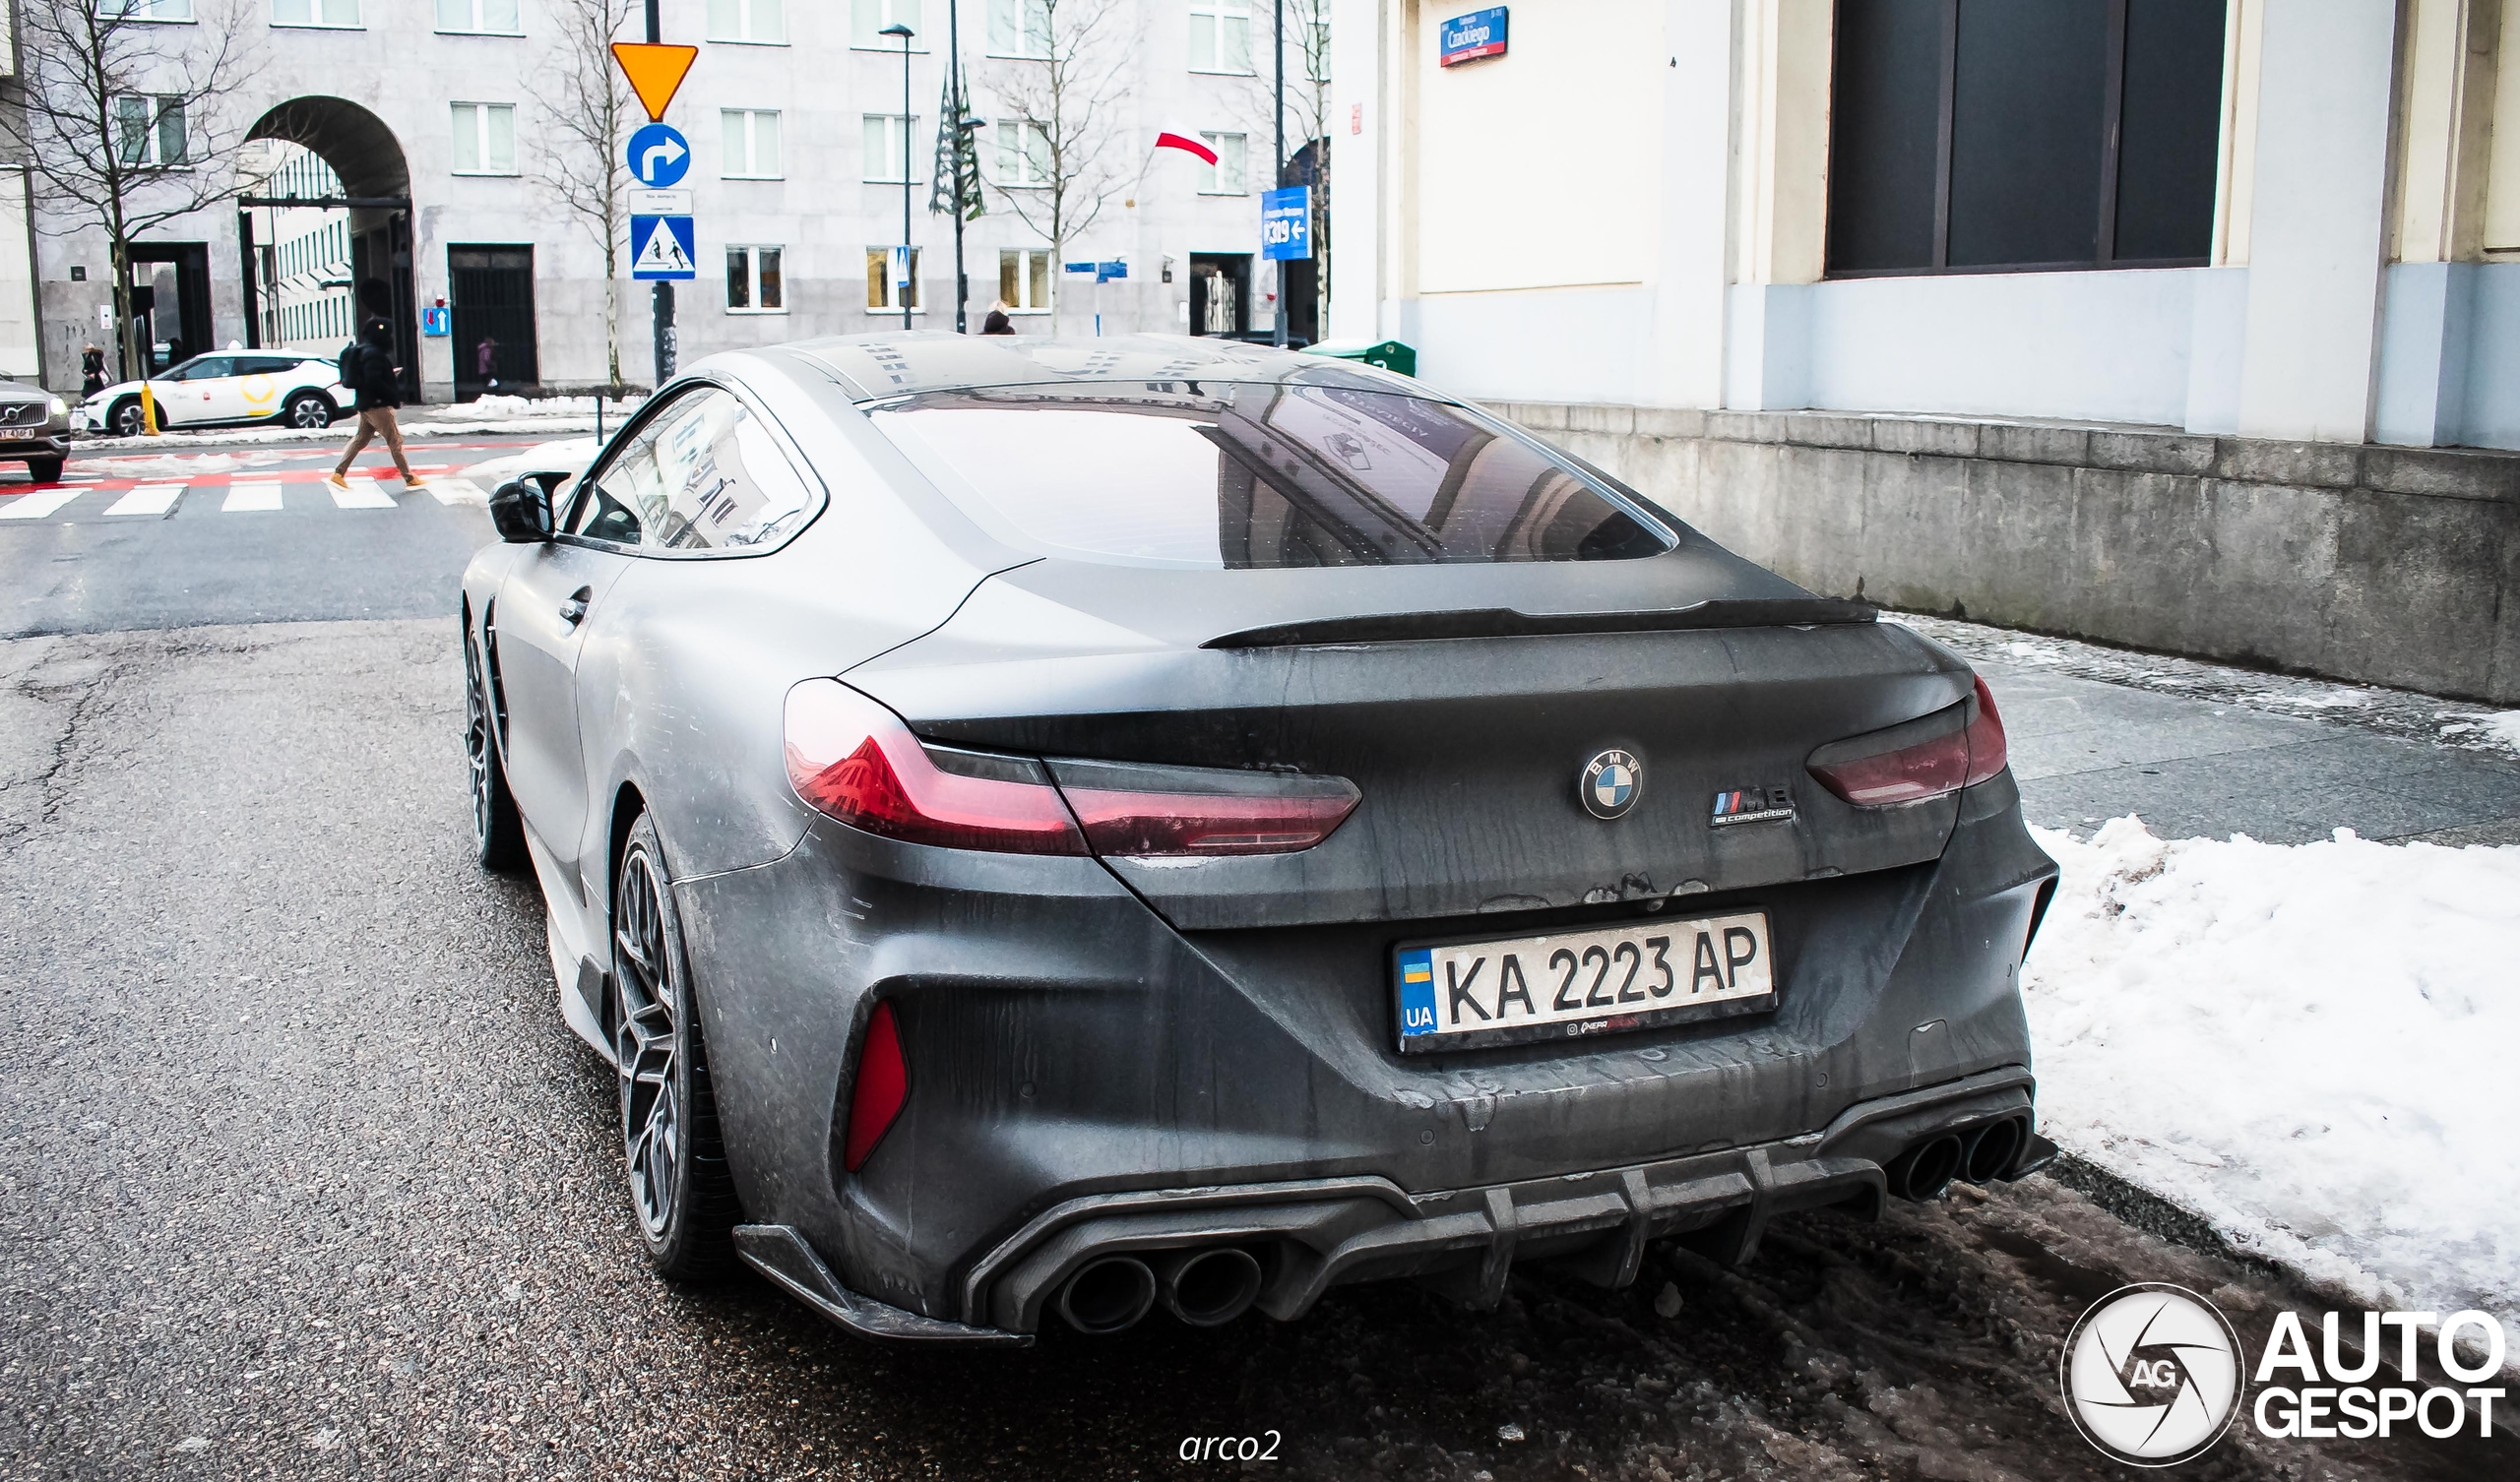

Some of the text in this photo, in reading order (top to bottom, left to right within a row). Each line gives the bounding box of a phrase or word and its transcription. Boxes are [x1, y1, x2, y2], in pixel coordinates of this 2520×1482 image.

[1589, 752, 1640, 776] BMW
[1728, 809, 1793, 822] competition
[1445, 926, 1757, 1025] KA 2223 AP
[1406, 1007, 1434, 1028] UA
